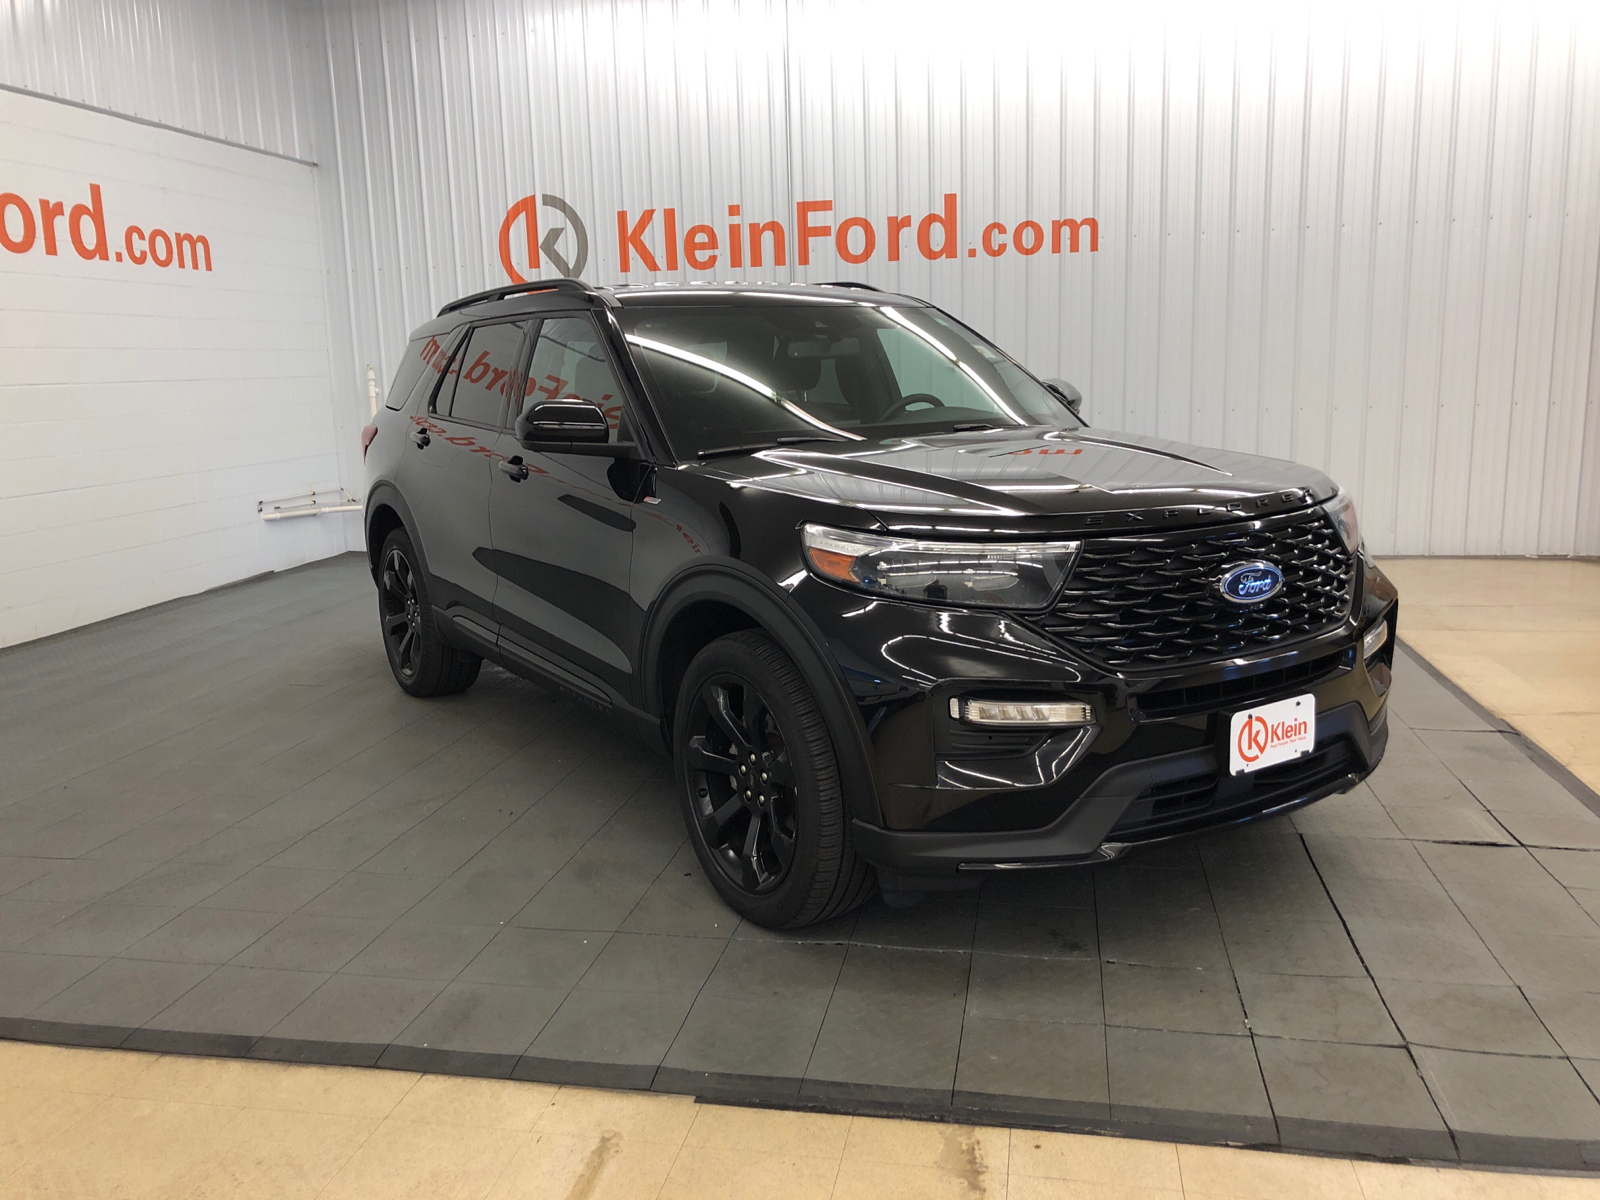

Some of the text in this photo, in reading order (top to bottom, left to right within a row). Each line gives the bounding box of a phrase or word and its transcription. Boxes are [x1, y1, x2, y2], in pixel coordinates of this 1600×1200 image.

[616, 192, 1099, 273] KleinFord.com
[1084, 488, 1315, 525] EXPLORER
[1238, 570, 1272, 595] Ford
[1270, 717, 1308, 743] Klein
